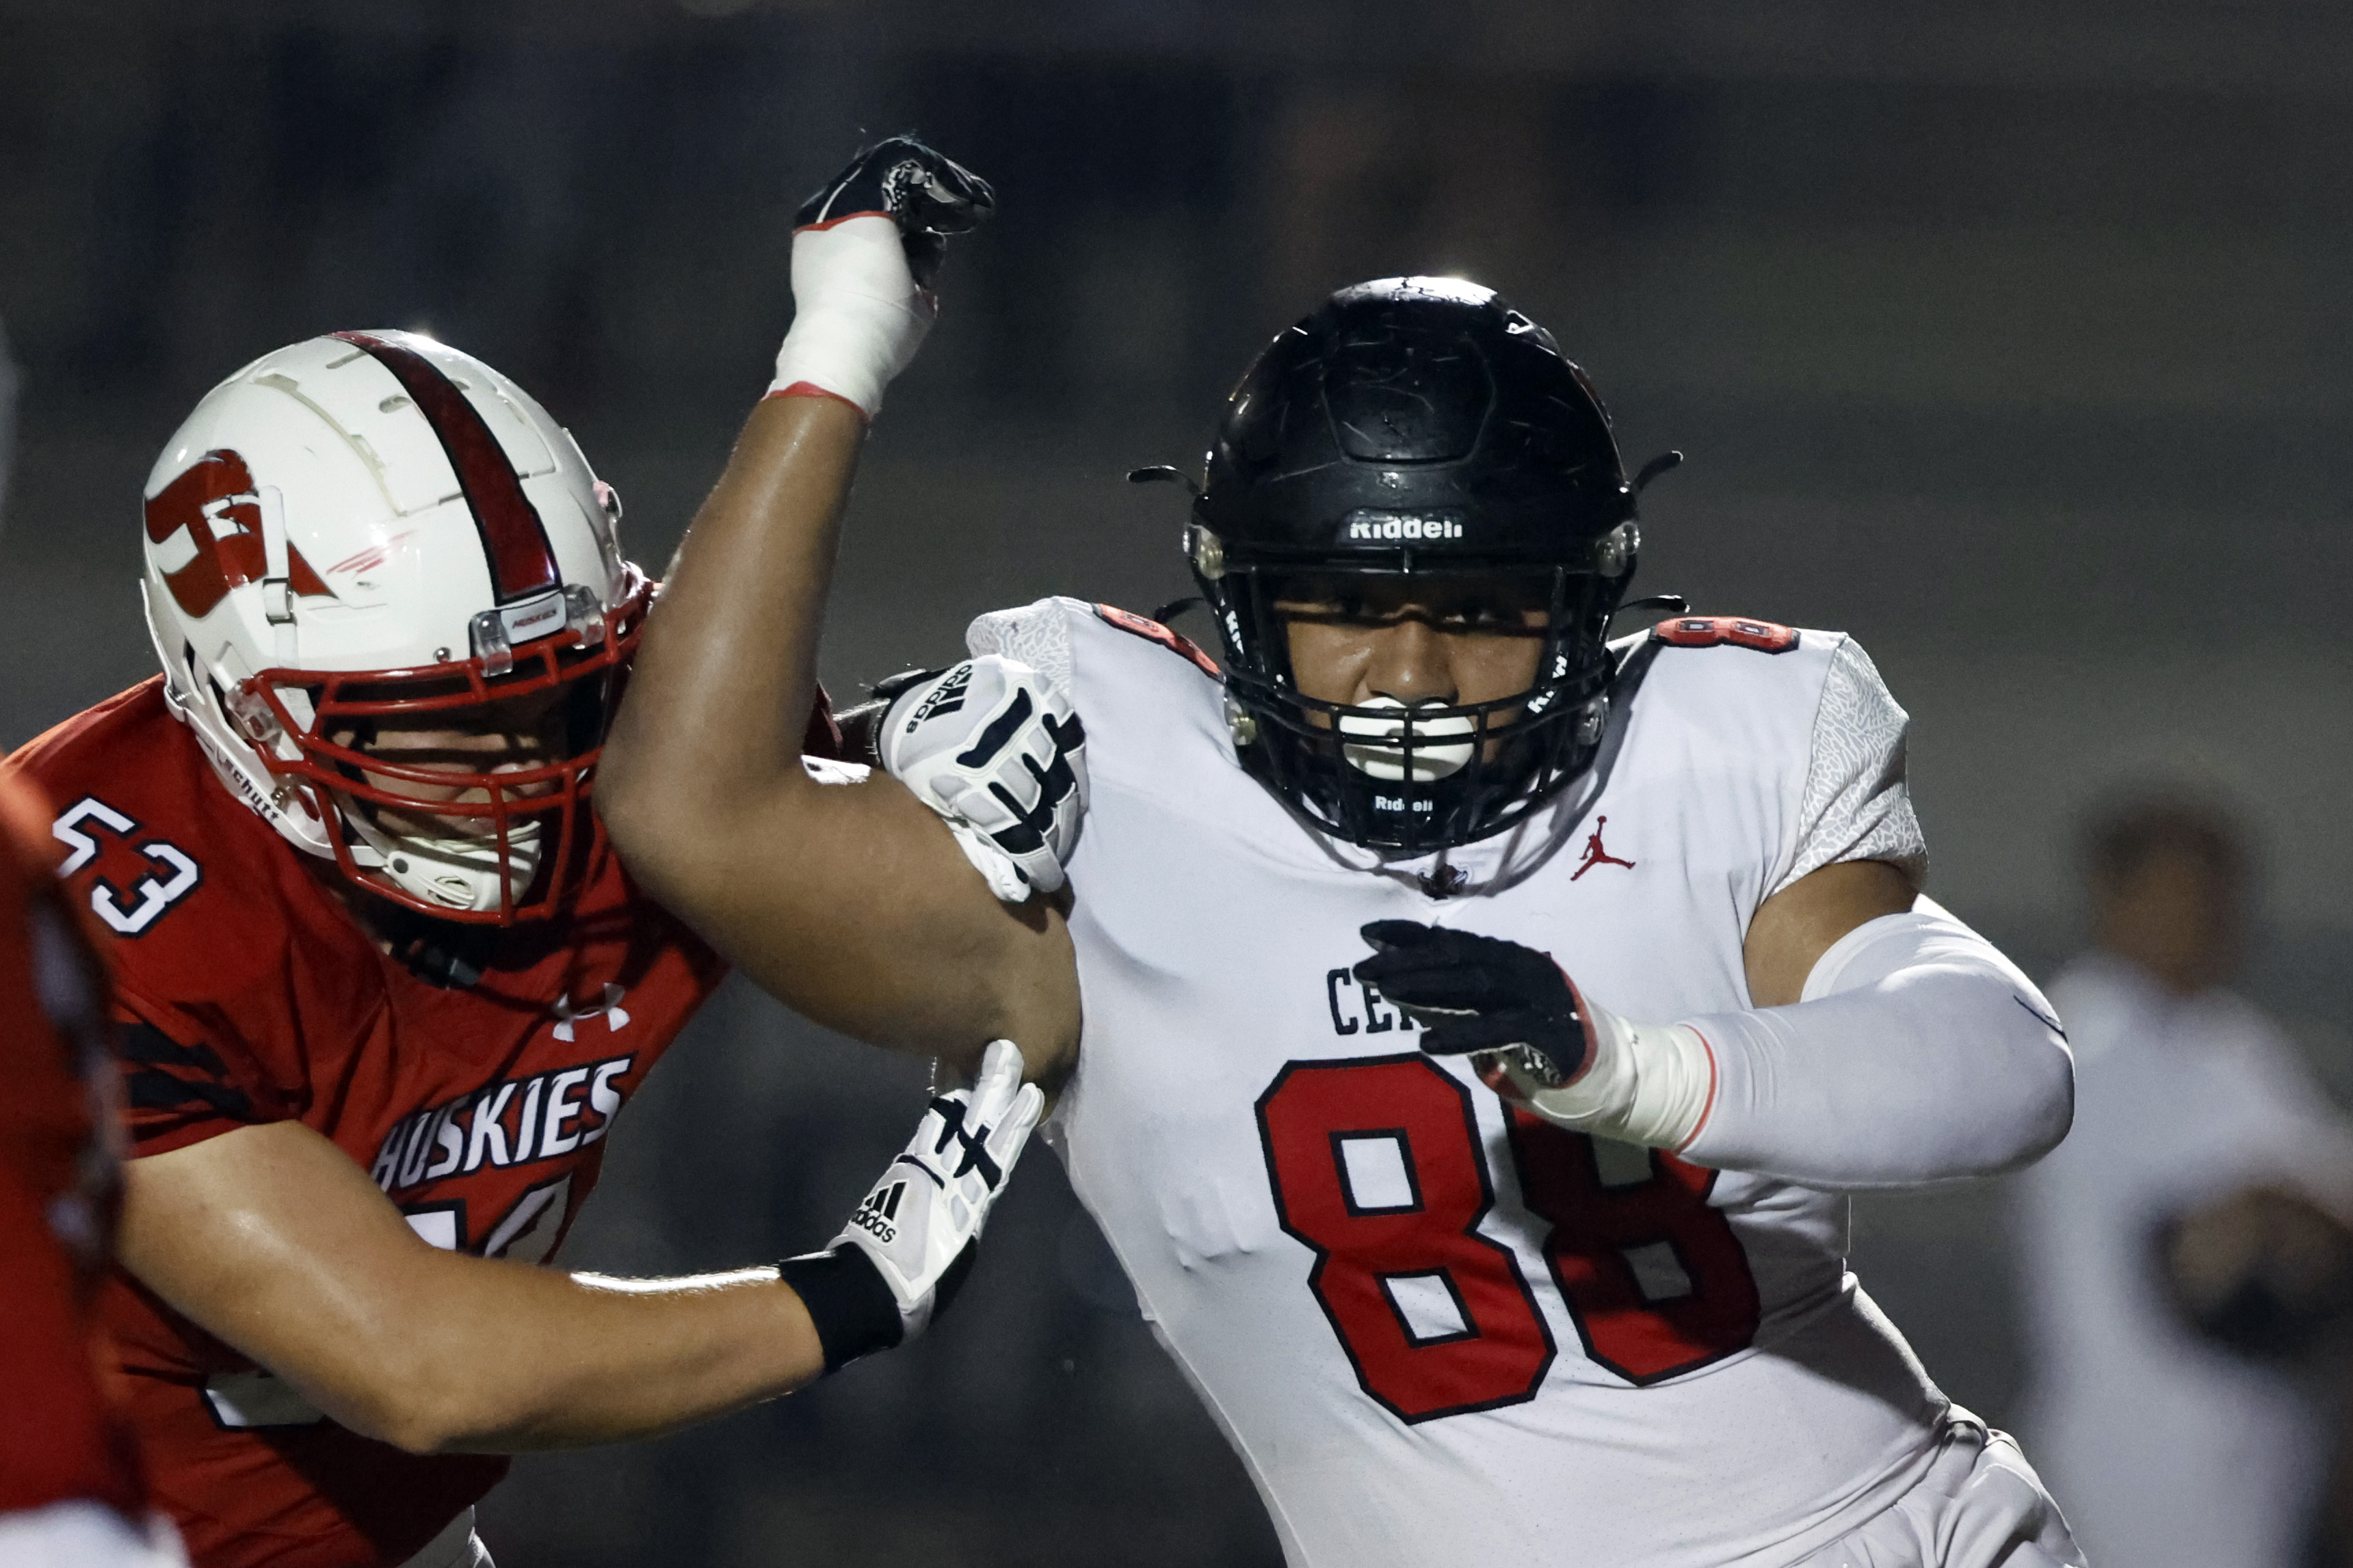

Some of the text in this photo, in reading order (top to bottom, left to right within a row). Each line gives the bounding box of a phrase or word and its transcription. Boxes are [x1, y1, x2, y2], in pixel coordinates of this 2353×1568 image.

[51, 795, 201, 935] 53
[1375, 795, 1434, 812] Ridell
[370, 1057, 632, 1194] HUSKIES
[1254, 1052, 1761, 1425] 88
